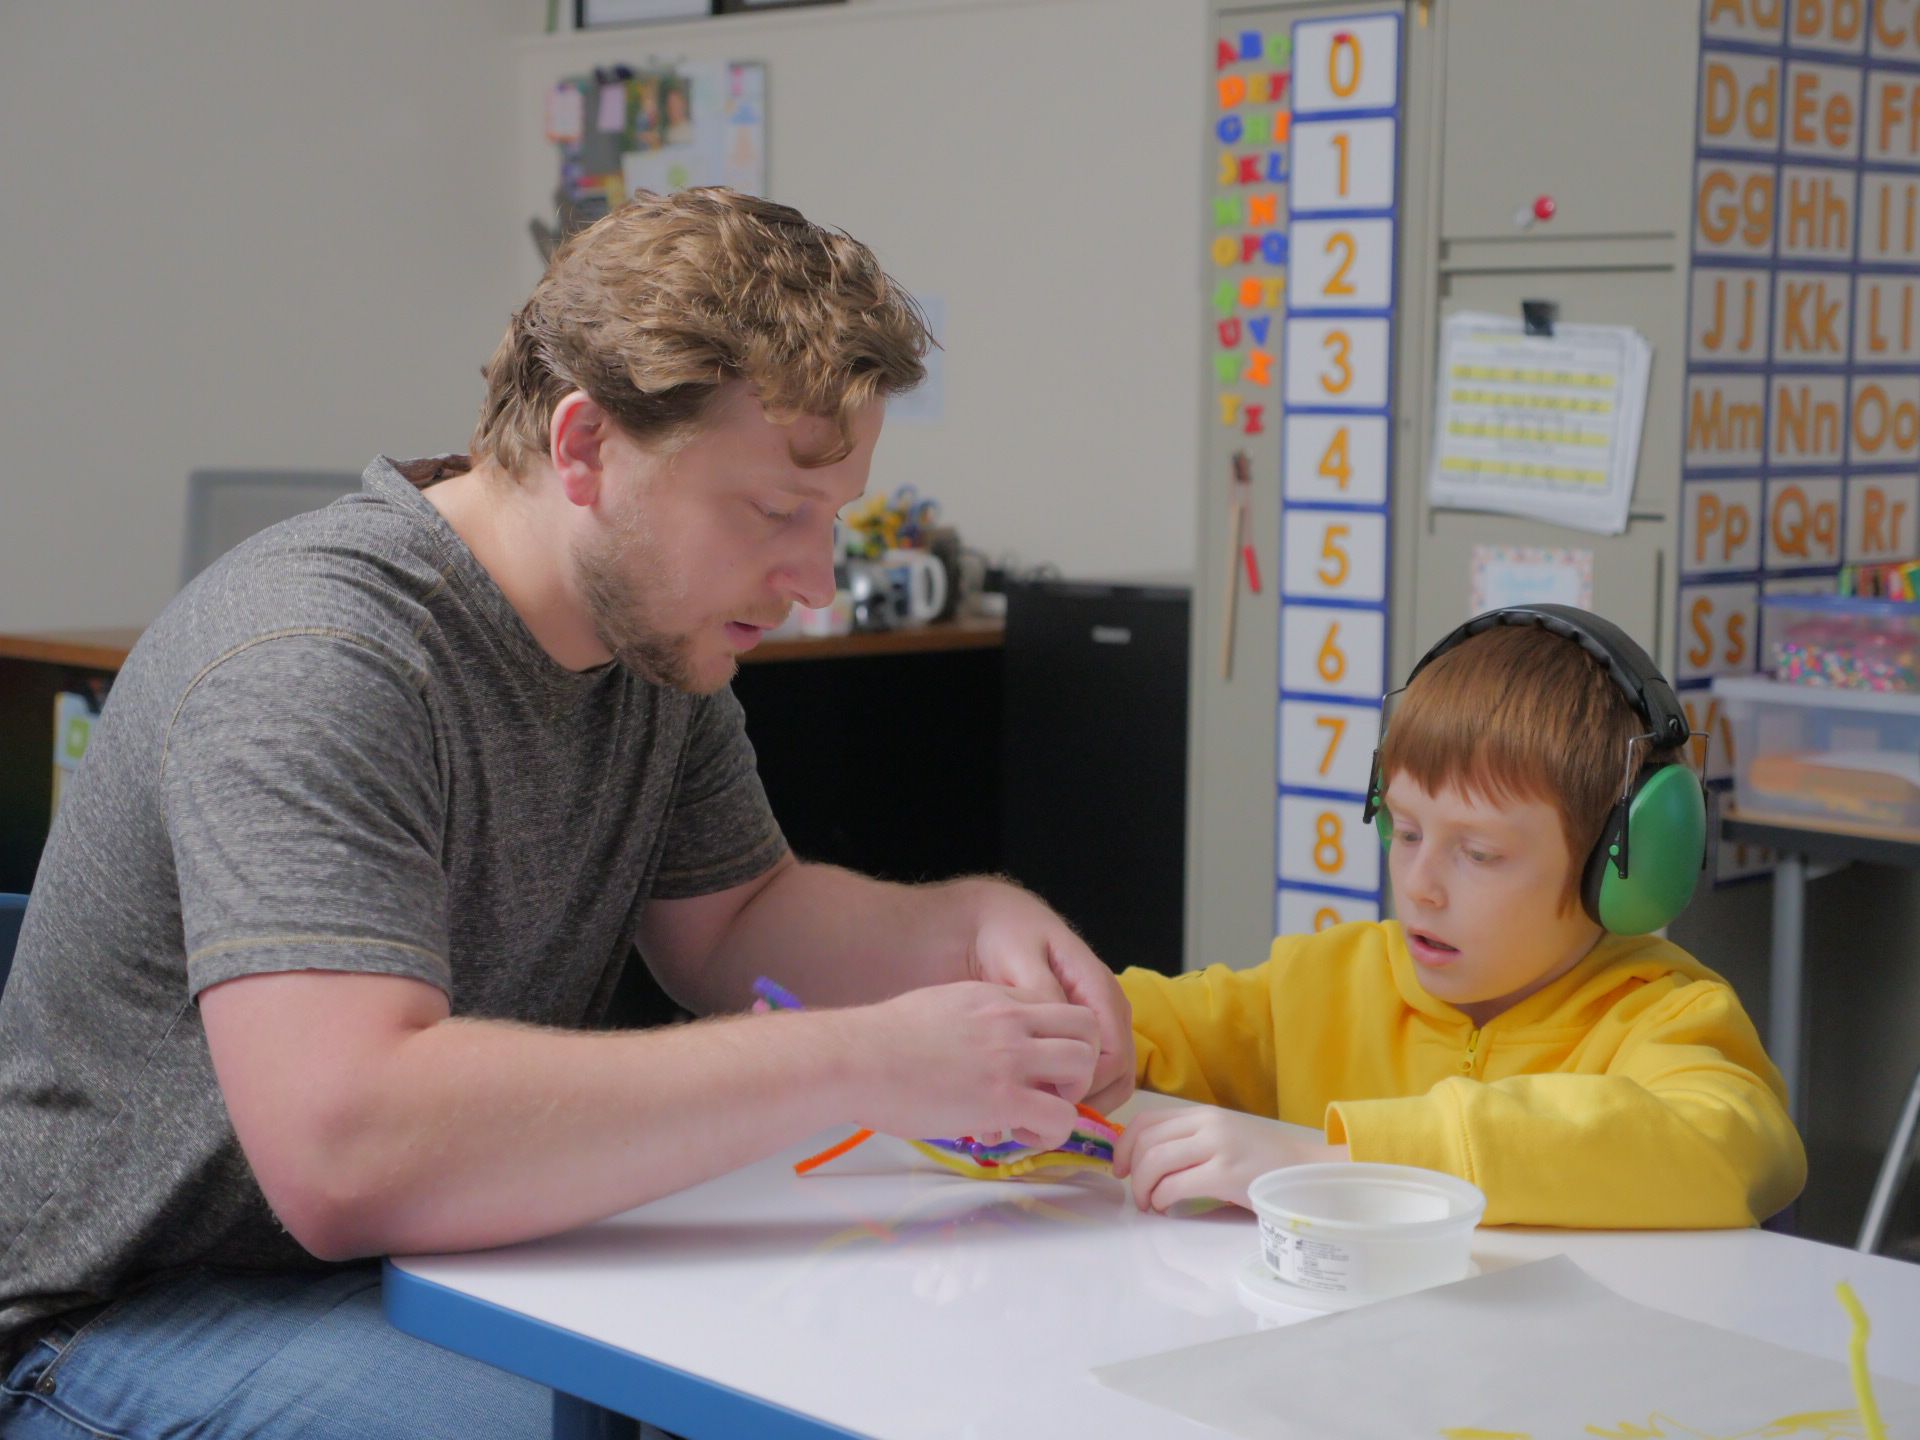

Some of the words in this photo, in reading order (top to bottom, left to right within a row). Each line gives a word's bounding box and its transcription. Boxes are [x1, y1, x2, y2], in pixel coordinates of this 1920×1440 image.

[1874, 0, 1920, 48] C
[1328, 32, 1362, 98] 0
[1705, 64, 1777, 139] Dd
[1793, 73, 1853, 147] Ee
[1332, 134, 1350, 196] 1
[1698, 171, 1773, 246] Gg
[1788, 180, 1848, 247] Hh
[1323, 232, 1356, 295] 2
[1702, 279, 1756, 351] Jj
[1784, 283, 1840, 352] Kk
[1321, 331, 1353, 395] 3
[1688, 390, 1762, 449] Mm
[1776, 387, 1839, 453] Nn
[1853, 384, 1920, 452] Oo
[1318, 428, 1351, 490] 4
[1696, 492, 1751, 560] Pp
[1771, 485, 1836, 557] Qq
[1861, 488, 1905, 551] Rr
[1318, 525, 1349, 587] 5
[1317, 623, 1347, 683] 6
[1688, 597, 1746, 668] Ss
[1316, 716, 1347, 775] 7
[1313, 811, 1345, 874] 8
